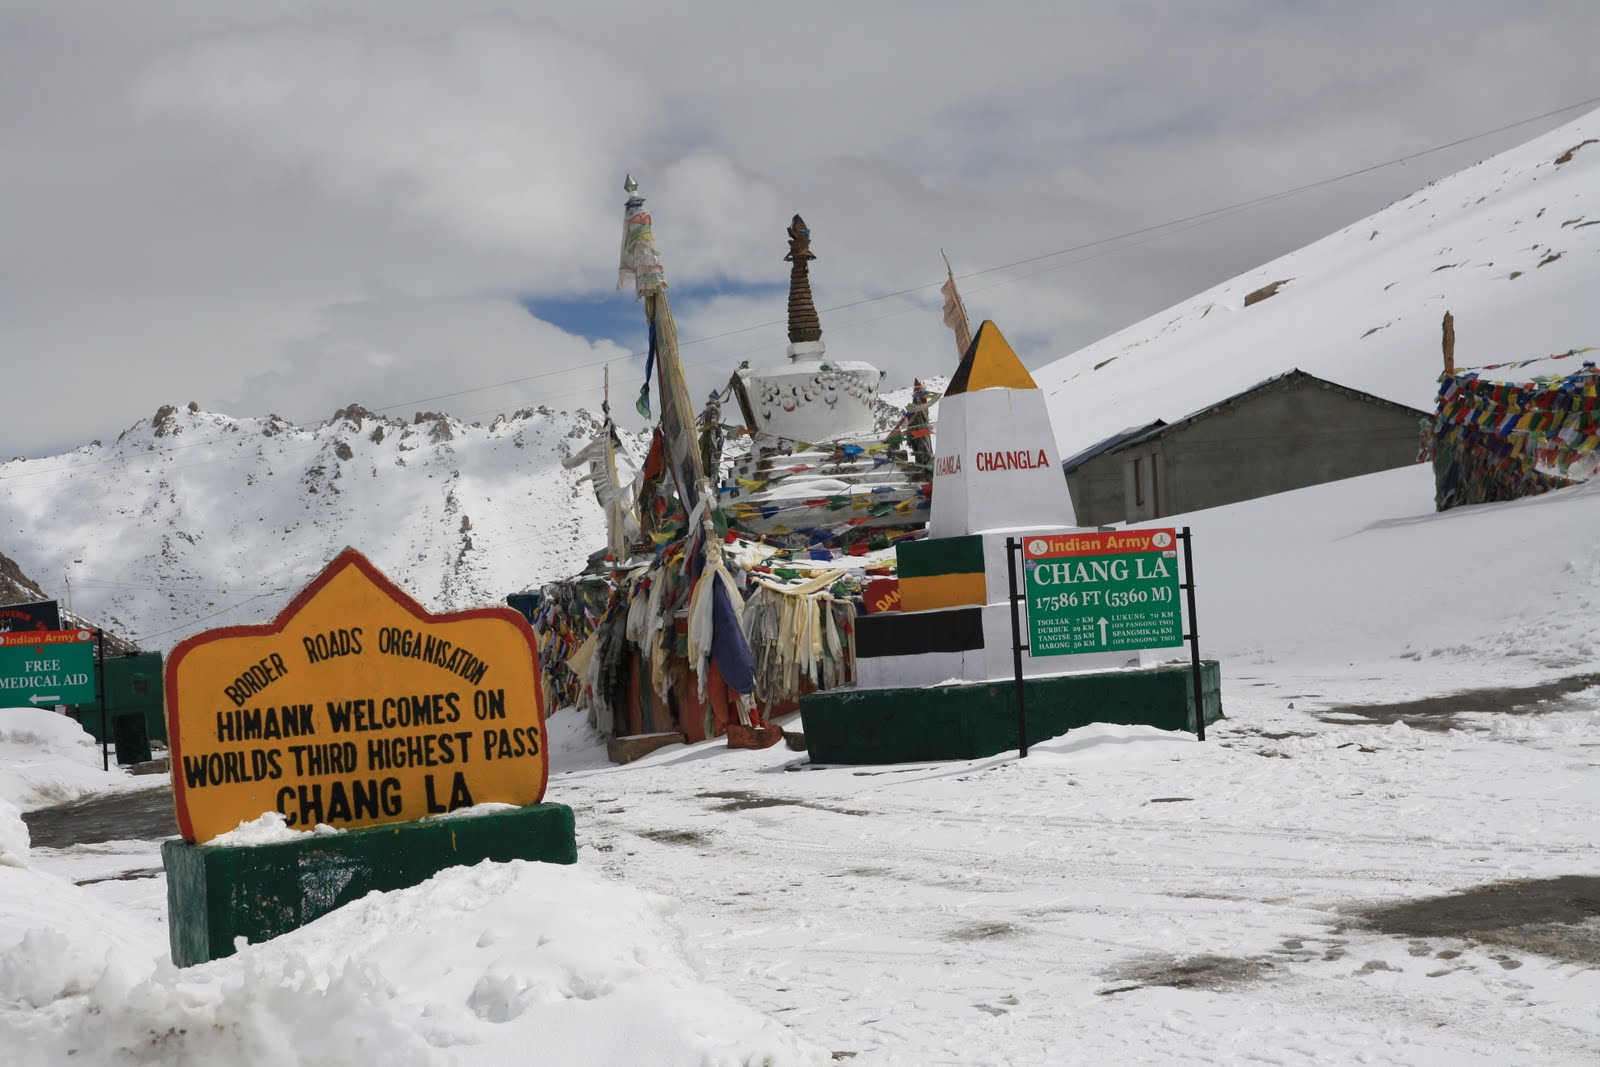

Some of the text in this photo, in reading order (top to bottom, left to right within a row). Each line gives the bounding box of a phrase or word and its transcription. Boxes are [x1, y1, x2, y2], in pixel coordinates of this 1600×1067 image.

[976, 449, 1050, 471] CHANGLA
[1049, 536, 1151, 553] Indian Army
[1033, 557, 1171, 586] CHANG LA
[1036, 586, 1172, 612] 17586 FT (5360 M)
[1037, 618, 1070, 626] TSOLTAK
[1111, 613, 1145, 621] LUKUNG
[1125, 620, 1157, 628] PANGONG
[1037, 626, 1069, 634] DURBUK
[1112, 629, 1151, 637] SPANGMIK
[5, 633, 75, 645] Indian Army
[1039, 634, 1071, 642] TANGTSE
[1126, 636, 1158, 644] PANGONG
[1039, 642, 1070, 650] HARONG
[25, 659, 60, 673] FREE
[224, 627, 489, 707] BORDER ROADS ORGANISATION
[0, 673, 88, 690] MEDICAL AID
[216, 689, 506, 742] HIMANK WELCOMES ON
[183, 726, 540, 789] WORLDS THIRD HIGHEST PASS
[275, 771, 474, 827] CHANG LA
